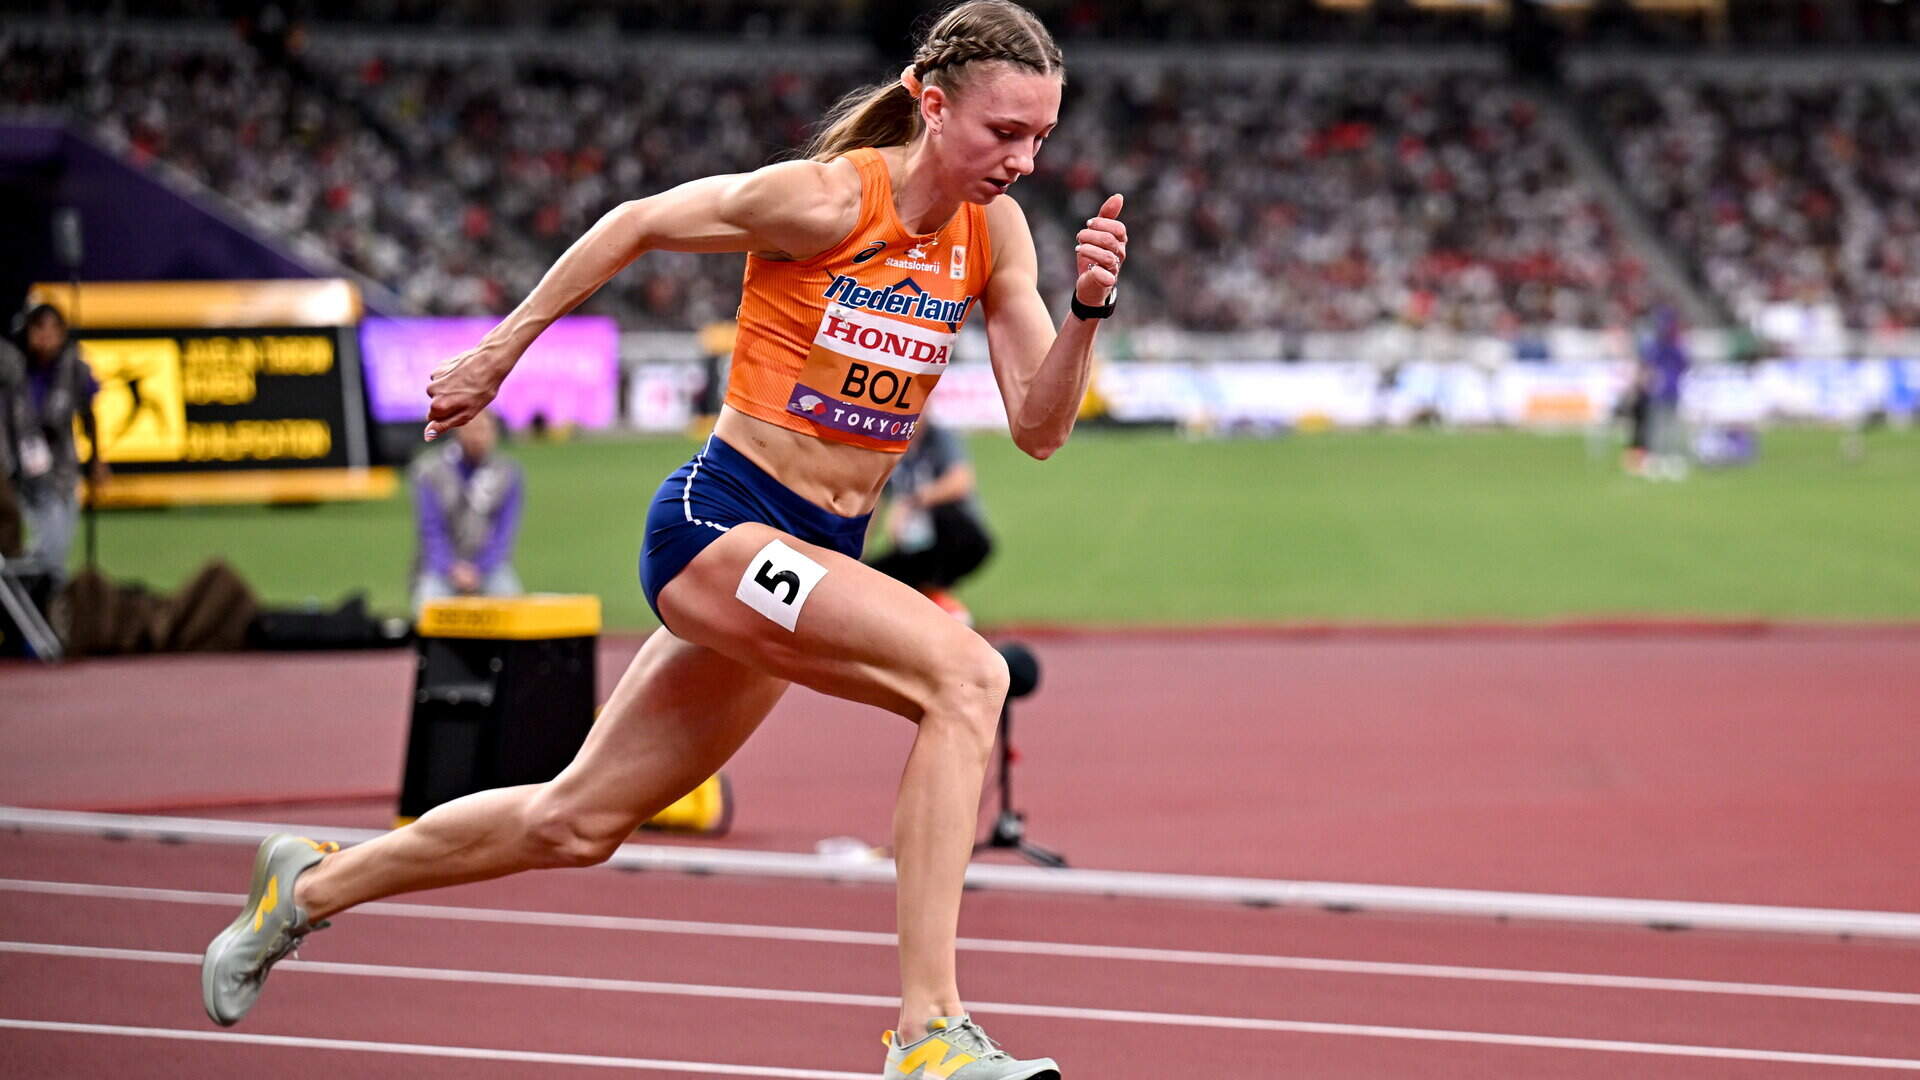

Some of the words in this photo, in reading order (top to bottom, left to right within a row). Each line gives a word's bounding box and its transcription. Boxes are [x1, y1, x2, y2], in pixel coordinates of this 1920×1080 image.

[885, 257, 940, 274] Staatsloterij
[822, 315, 948, 364] HONDA
[840, 362, 913, 409] BOL
[753, 559, 801, 606] 5
